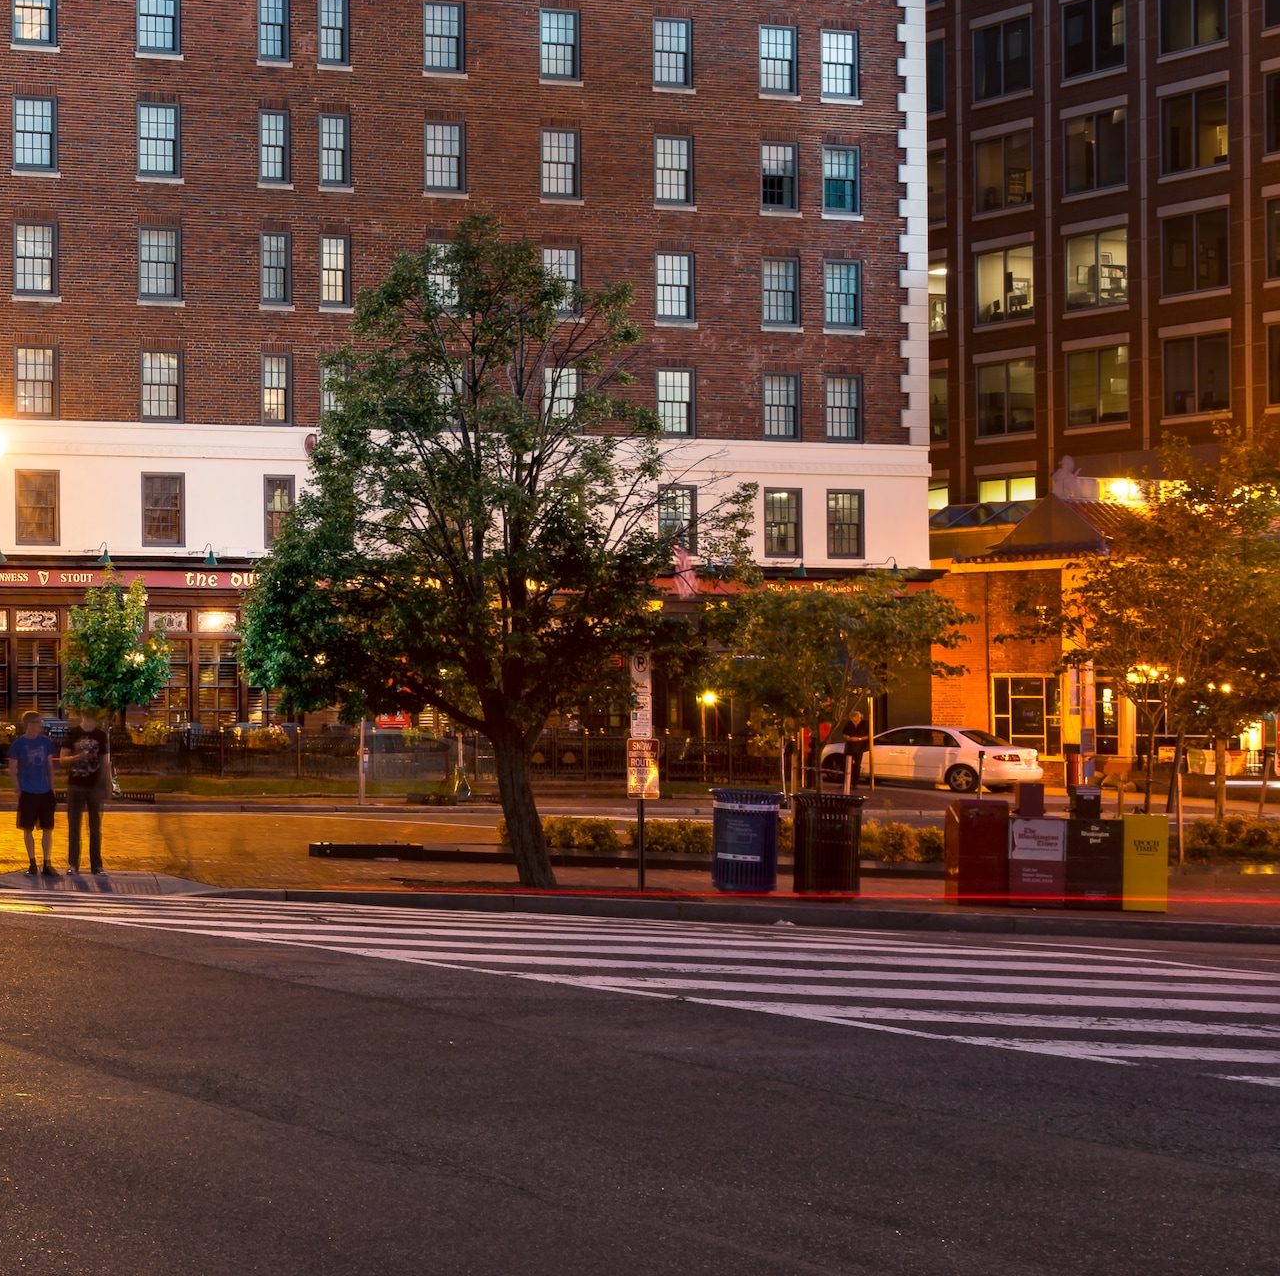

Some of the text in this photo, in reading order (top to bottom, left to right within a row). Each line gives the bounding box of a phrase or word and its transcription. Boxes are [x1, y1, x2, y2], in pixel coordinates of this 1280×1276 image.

[60, 573, 94, 583] STOUT
[632, 741, 653, 751] SNOW
[629, 750, 657, 758] EMERGENCY
[630, 758, 655, 767] ROUTE
[1133, 839, 1160, 847] EPOCH
